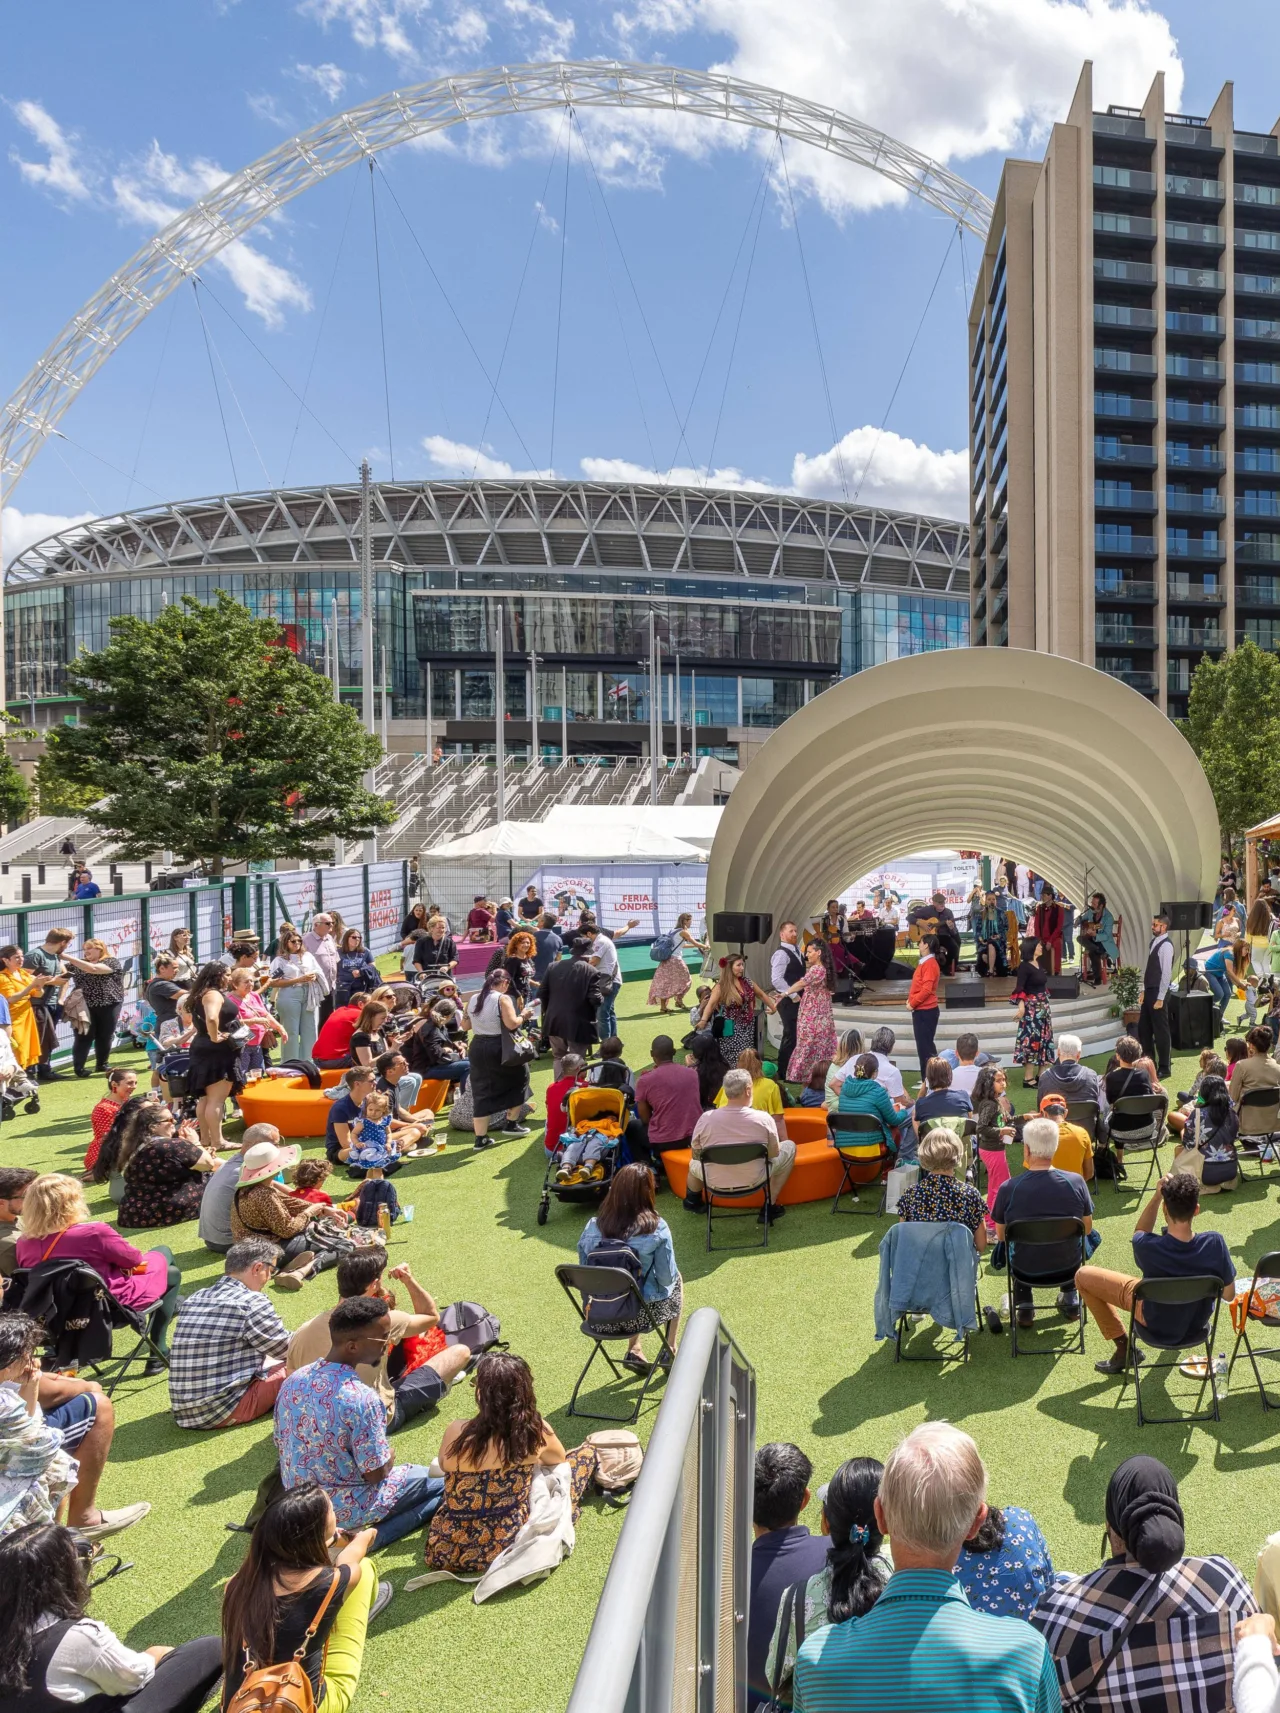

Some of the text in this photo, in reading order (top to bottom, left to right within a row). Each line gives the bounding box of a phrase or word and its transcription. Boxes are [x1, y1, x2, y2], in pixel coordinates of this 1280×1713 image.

[866, 874, 907, 889] VICTORIA
[549, 879, 594, 895] VICTORIA
[622, 894, 650, 902] FERIA
[925, 896, 964, 904] LODRES
[614, 902, 659, 911] LONDRES
